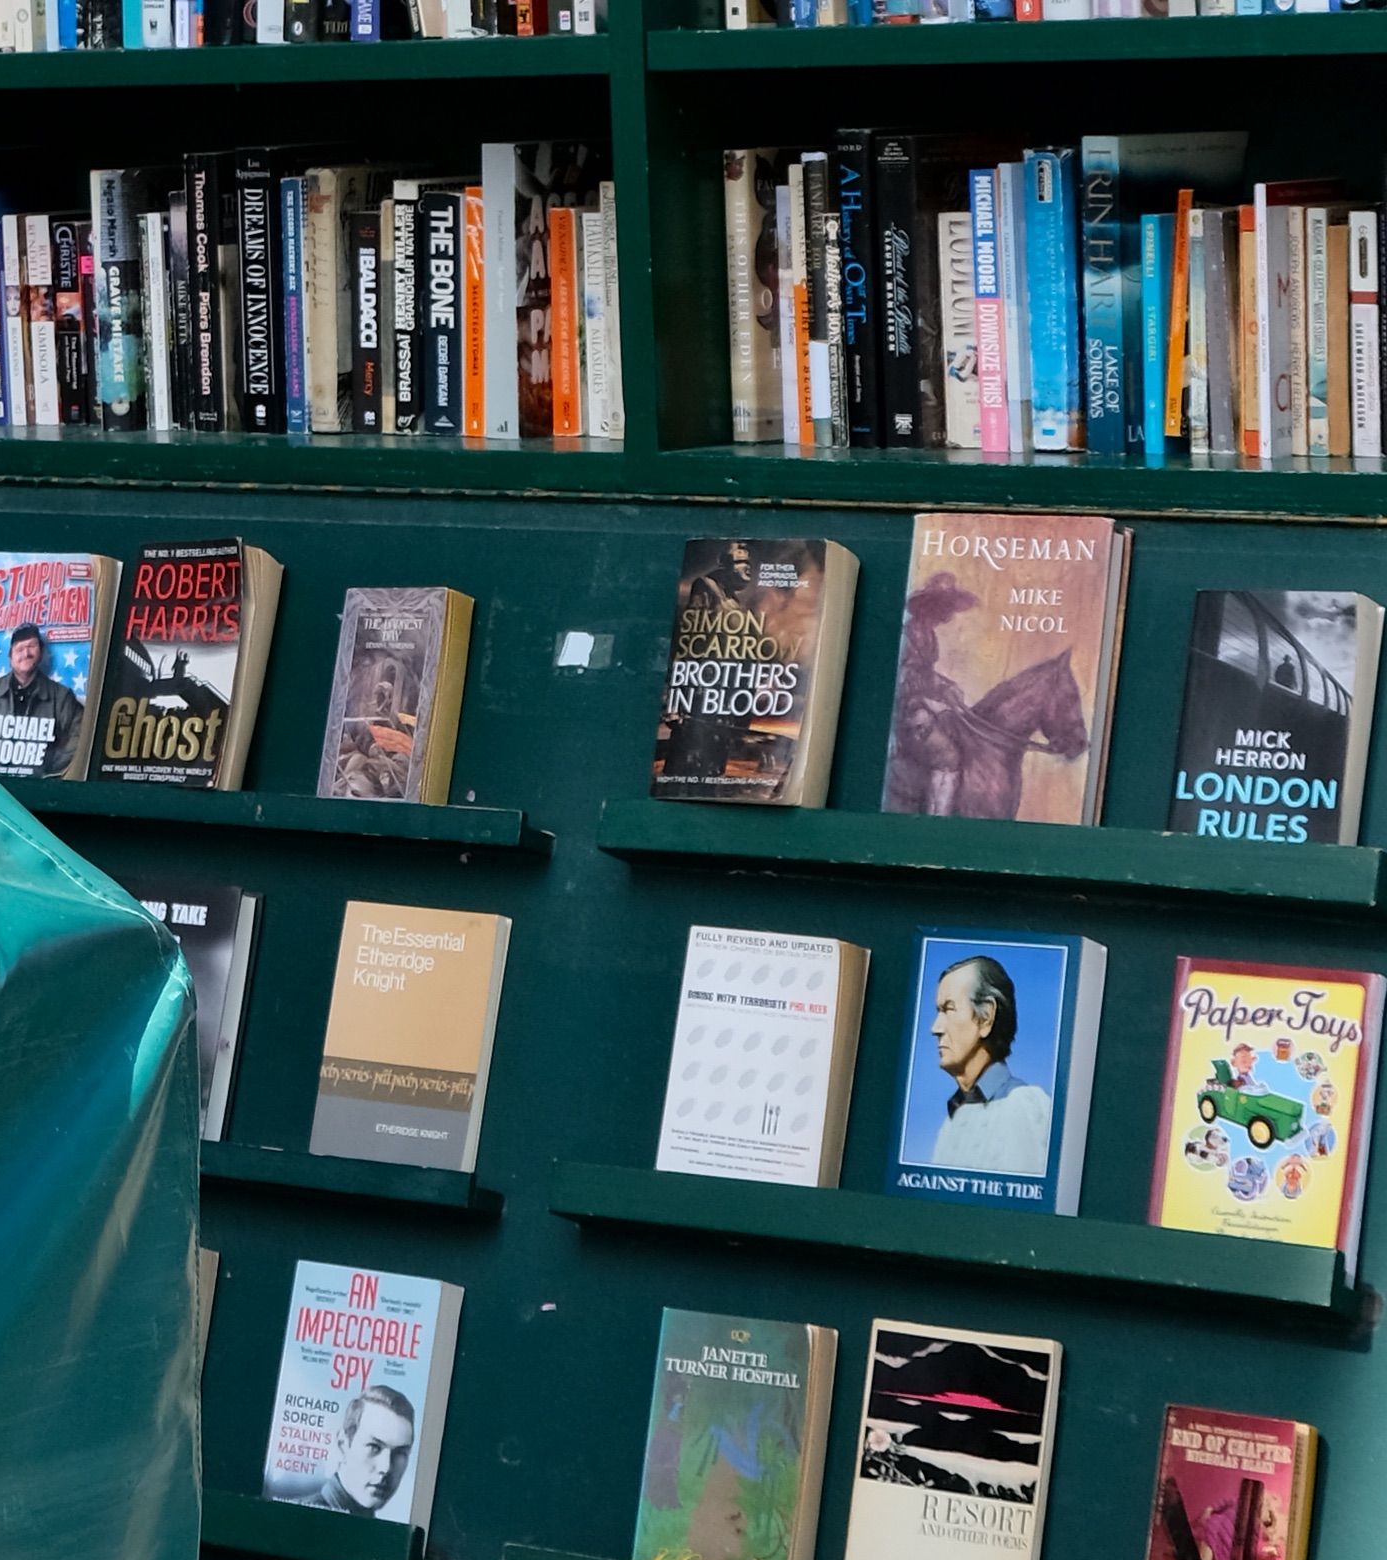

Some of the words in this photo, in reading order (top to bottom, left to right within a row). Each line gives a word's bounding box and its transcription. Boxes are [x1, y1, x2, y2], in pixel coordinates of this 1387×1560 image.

[243, 188, 266, 260] DREAMS
[430, 205, 454, 255] THE
[247, 265, 266, 289] OF
[359, 256, 377, 348] BALDACCI
[431, 259, 455, 329] BONE
[247, 293, 270, 395] INNOCENCE
[923, 530, 1097, 571] HORSEMAN
[135, 562, 240, 600] ROBERT
[49, 586, 89, 625] MEN
[1009, 588, 1064, 606] MIKE
[126, 604, 240, 642] HARRIS
[681, 609, 766, 635] SIMON
[1000, 615, 1068, 634] NICOL
[677, 634, 803, 662] SCARROW
[672, 661, 799, 690] BROTHERS
[667, 688, 694, 714] IN
[702, 689, 793, 716] BLOOD
[104, 696, 222, 762] Ghost
[1235, 728, 1291, 750] MICK
[1215, 748, 1307, 771] HERRON
[1176, 770, 1338, 810] LONDON
[1197, 808, 1309, 844] RULES
[171, 902, 208, 926] TAKE
[362, 923, 392, 942] The
[393, 927, 466, 952] Essential
[696, 932, 723, 942] FULLY
[726, 935, 767, 947] REVISED
[769, 939, 789, 949] AND
[791, 940, 834, 954] UPDATED
[357, 945, 435, 972] Etheridge
[353, 968, 406, 993] Knight
[1184, 987, 1283, 1041] Paper
[1287, 990, 1360, 1053] Toys
[897, 1172, 968, 1193] AGAINST
[970, 1179, 1003, 1196] THE
[1006, 1181, 1044, 1200] TIDE
[348, 1272, 380, 1311] AN
[295, 1306, 423, 1360] IMPECCABLE
[700, 1345, 768, 1369] JANETTE
[331, 1354, 374, 1393] SPY
[664, 1357, 728, 1380] TURNER
[732, 1366, 801, 1389] HOSPITAL
[285, 1393, 340, 1414] RICHARD
[282, 1410, 325, 1428] SORGE
[280, 1425, 332, 1445] STALIN'S
[277, 1442, 329, 1461] MASTER
[274, 1458, 318, 1476] AGENT
[922, 1494, 1033, 1535] RESORT
